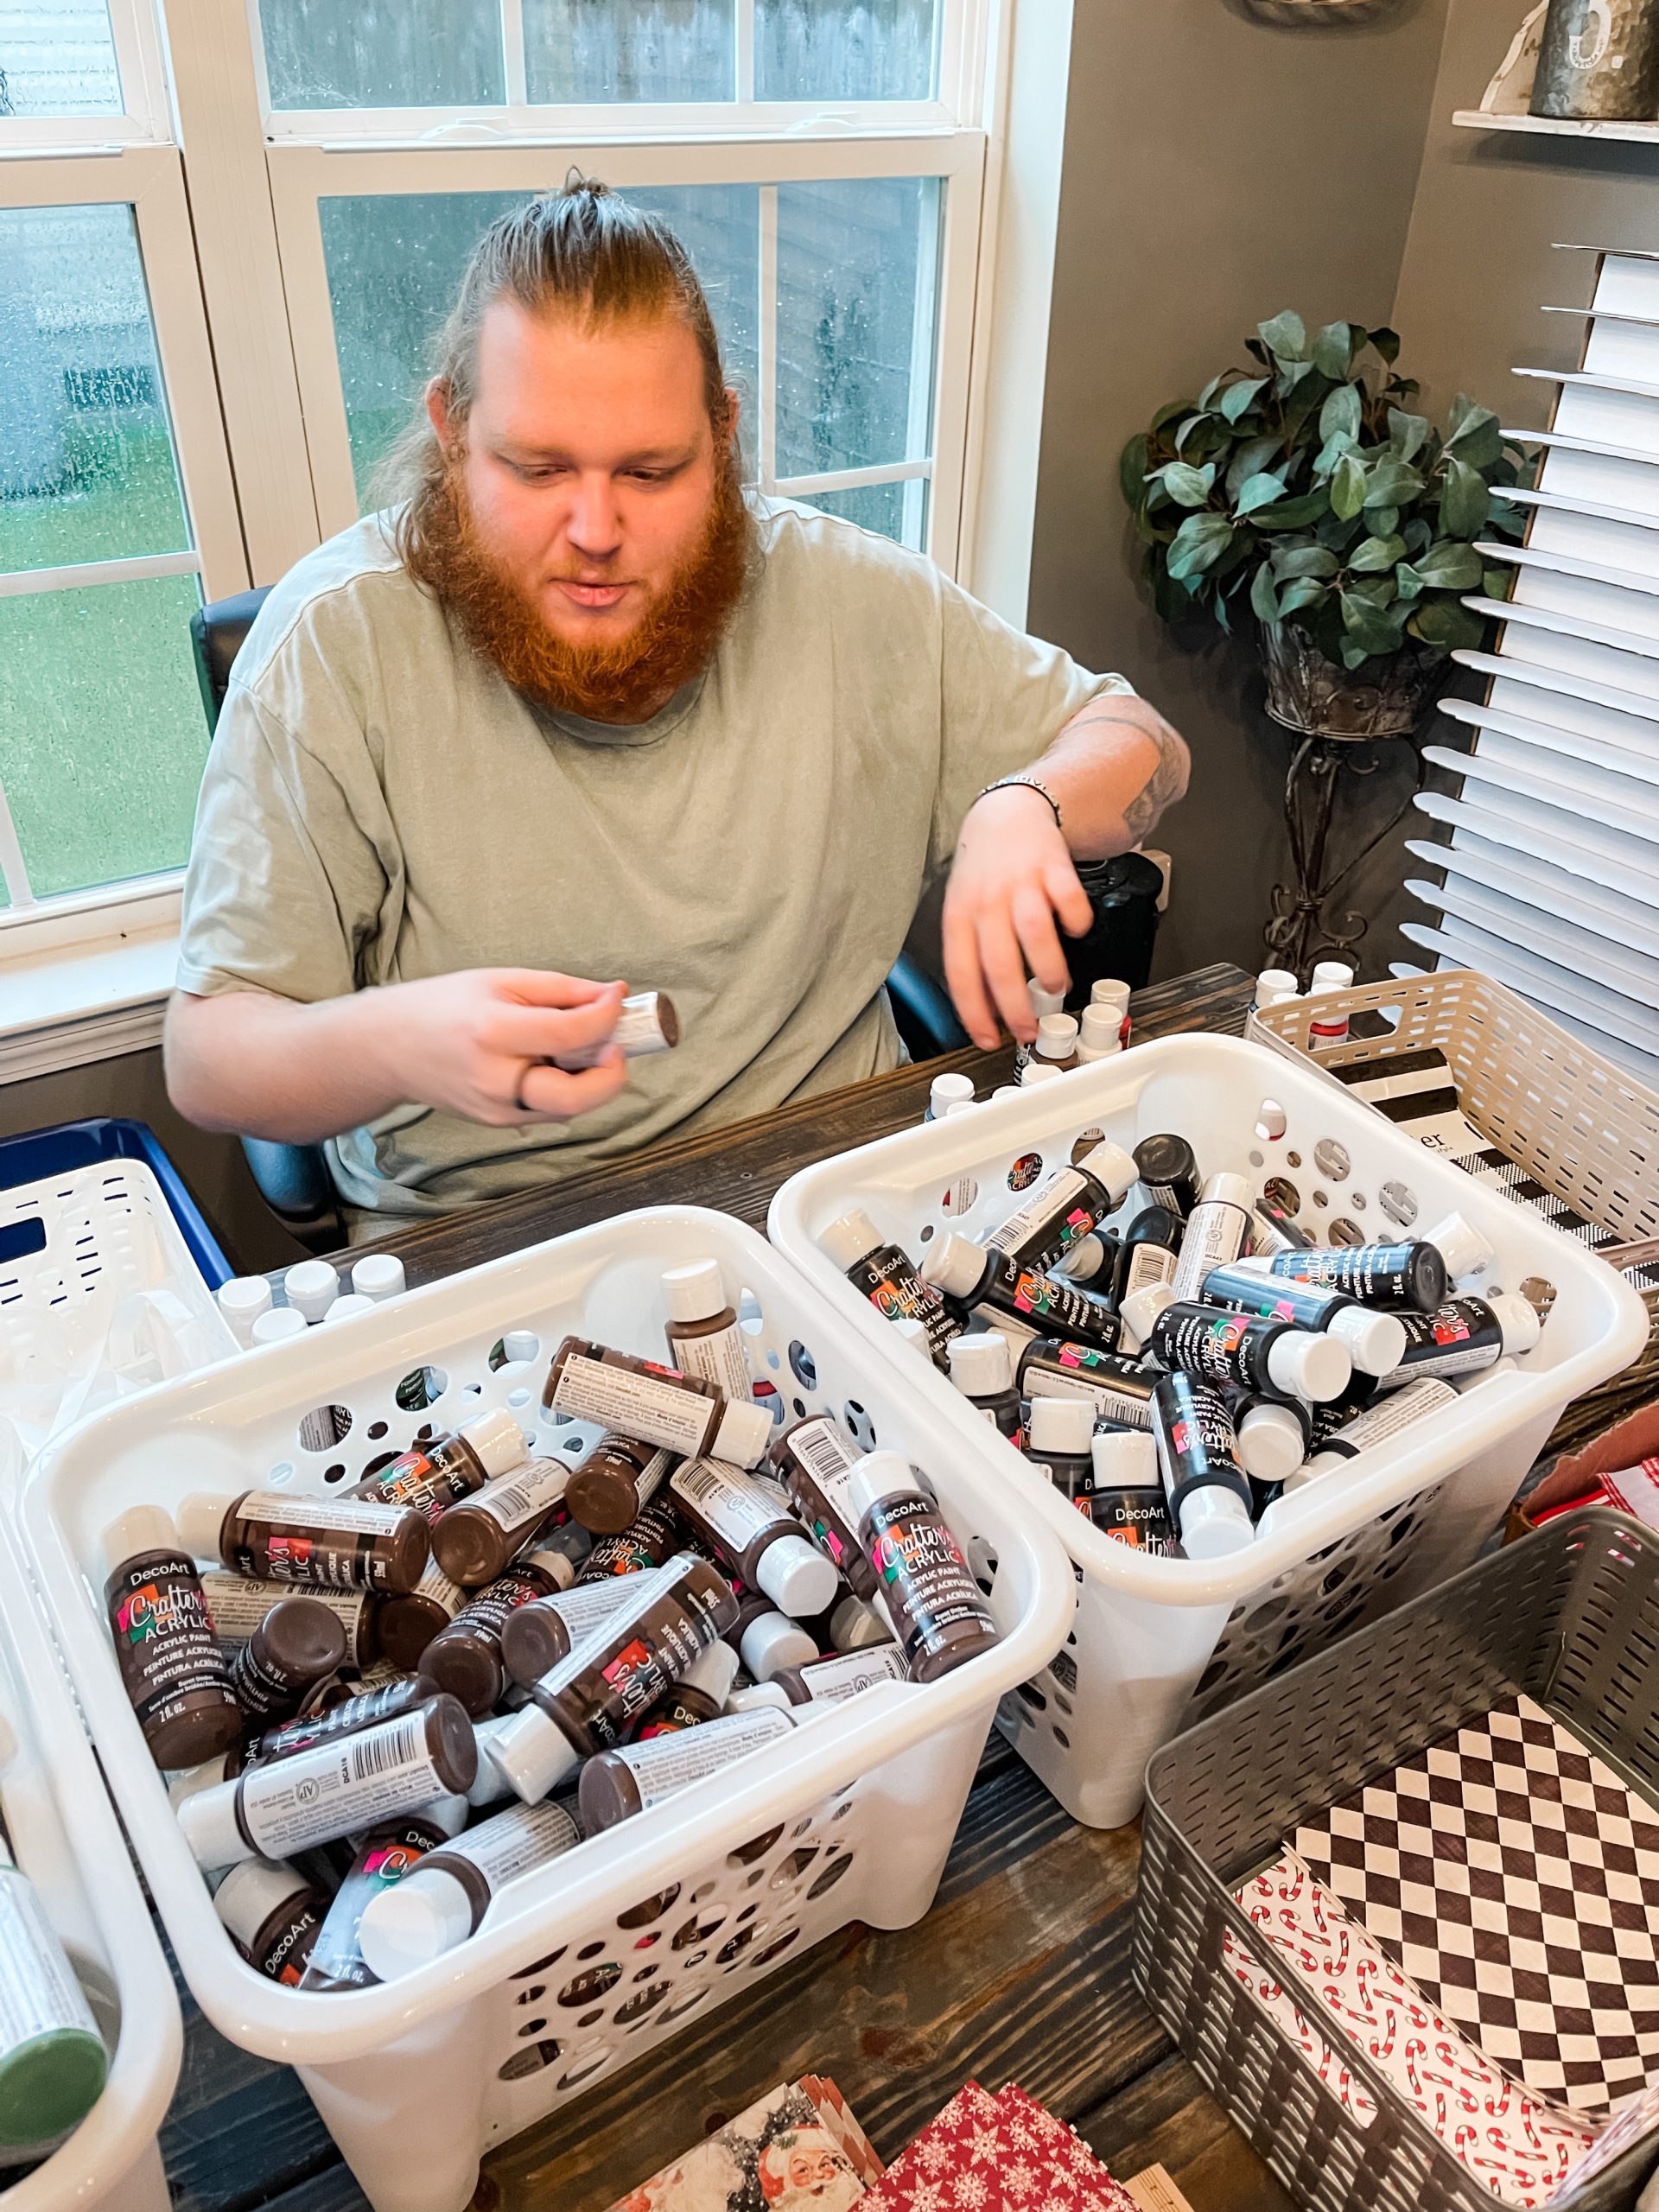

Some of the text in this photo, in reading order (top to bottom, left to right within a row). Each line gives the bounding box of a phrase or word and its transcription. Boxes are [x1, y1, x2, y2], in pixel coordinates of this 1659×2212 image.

[431, 1446, 465, 1492] DecoArt
[875, 1502, 929, 1529] DecoArt
[1116, 1506, 1165, 1522] DecoArt
[130, 1562, 190, 1586] DecoArt
[897, 1548, 960, 1582] ACRYLIC
[470, 1605, 510, 1620] ACRYLIQU
[912, 1598, 945, 1622] PINTURA
[145, 1614, 213, 1643] ACRYLIC
[152, 1636, 188, 1656] ACRYLIC
[143, 1650, 184, 1677] PEINTURE
[151, 1662, 192, 1687] PINTURA
[159, 1710, 166, 1723] 2
[264, 1911, 317, 1975] DecoArt
